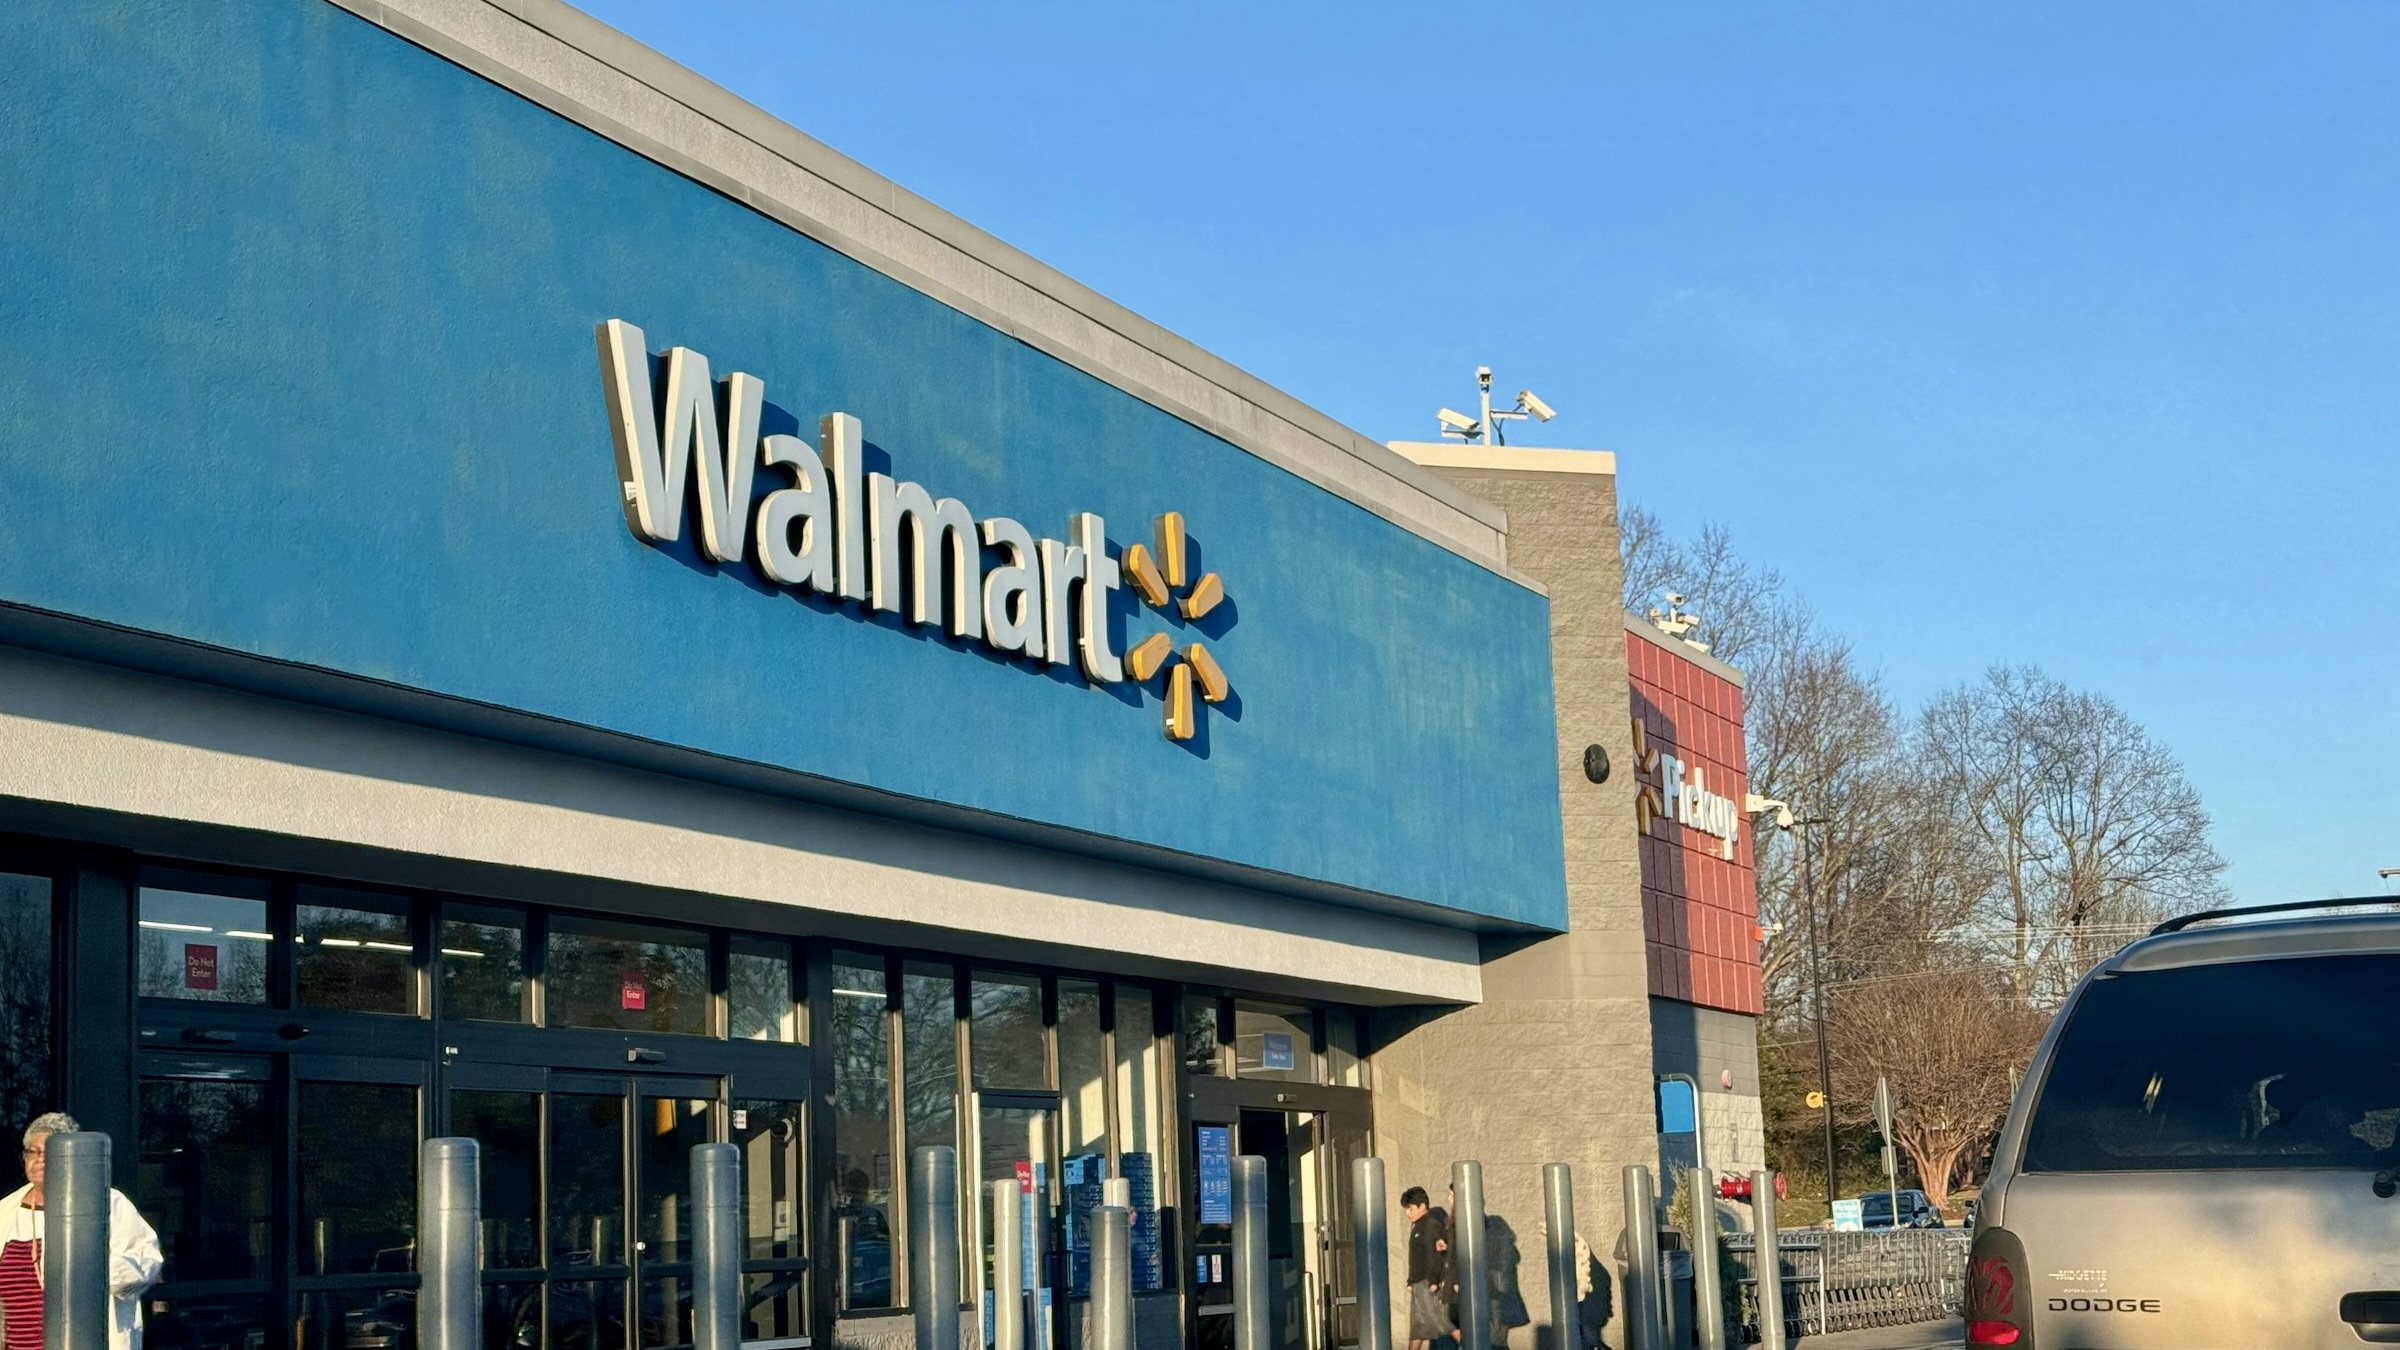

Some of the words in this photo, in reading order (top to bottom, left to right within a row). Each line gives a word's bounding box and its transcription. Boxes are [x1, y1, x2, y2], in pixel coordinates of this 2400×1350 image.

[597, 318, 1124, 683] Walmart
[1661, 753, 1738, 860] Pickup
[188, 956, 199, 966] Do
[201, 957, 214, 968] Not
[192, 967, 211, 978] Enter
[626, 990, 640, 999] Enter
[2048, 1298, 2161, 1313] DODGE
